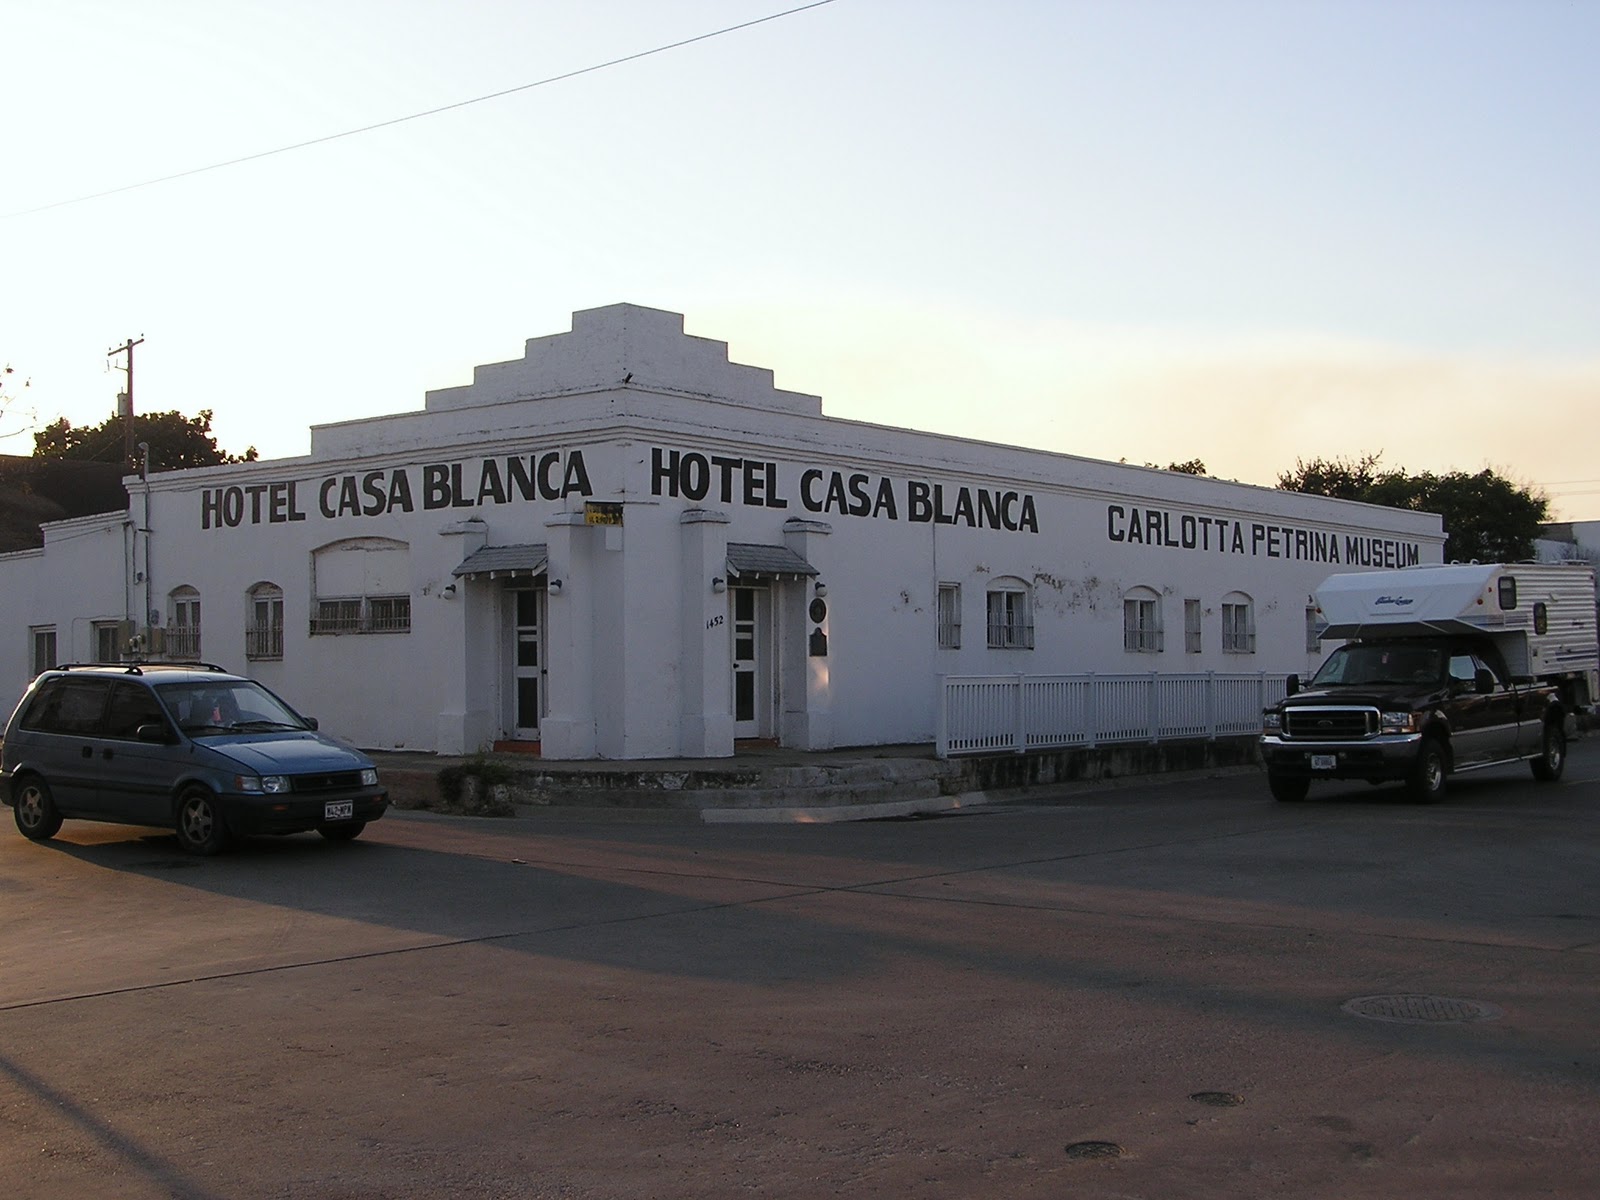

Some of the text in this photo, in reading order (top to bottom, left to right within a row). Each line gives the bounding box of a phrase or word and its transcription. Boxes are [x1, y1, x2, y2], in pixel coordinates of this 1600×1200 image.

[202, 450, 594, 530] HOTEL CASA BLANCA
[652, 447, 1039, 534] HOTEL CASA BLANCA
[1107, 504, 1419, 570] CARLOTTA PETRINA MUSEUM
[706, 615, 724, 629] 1452
